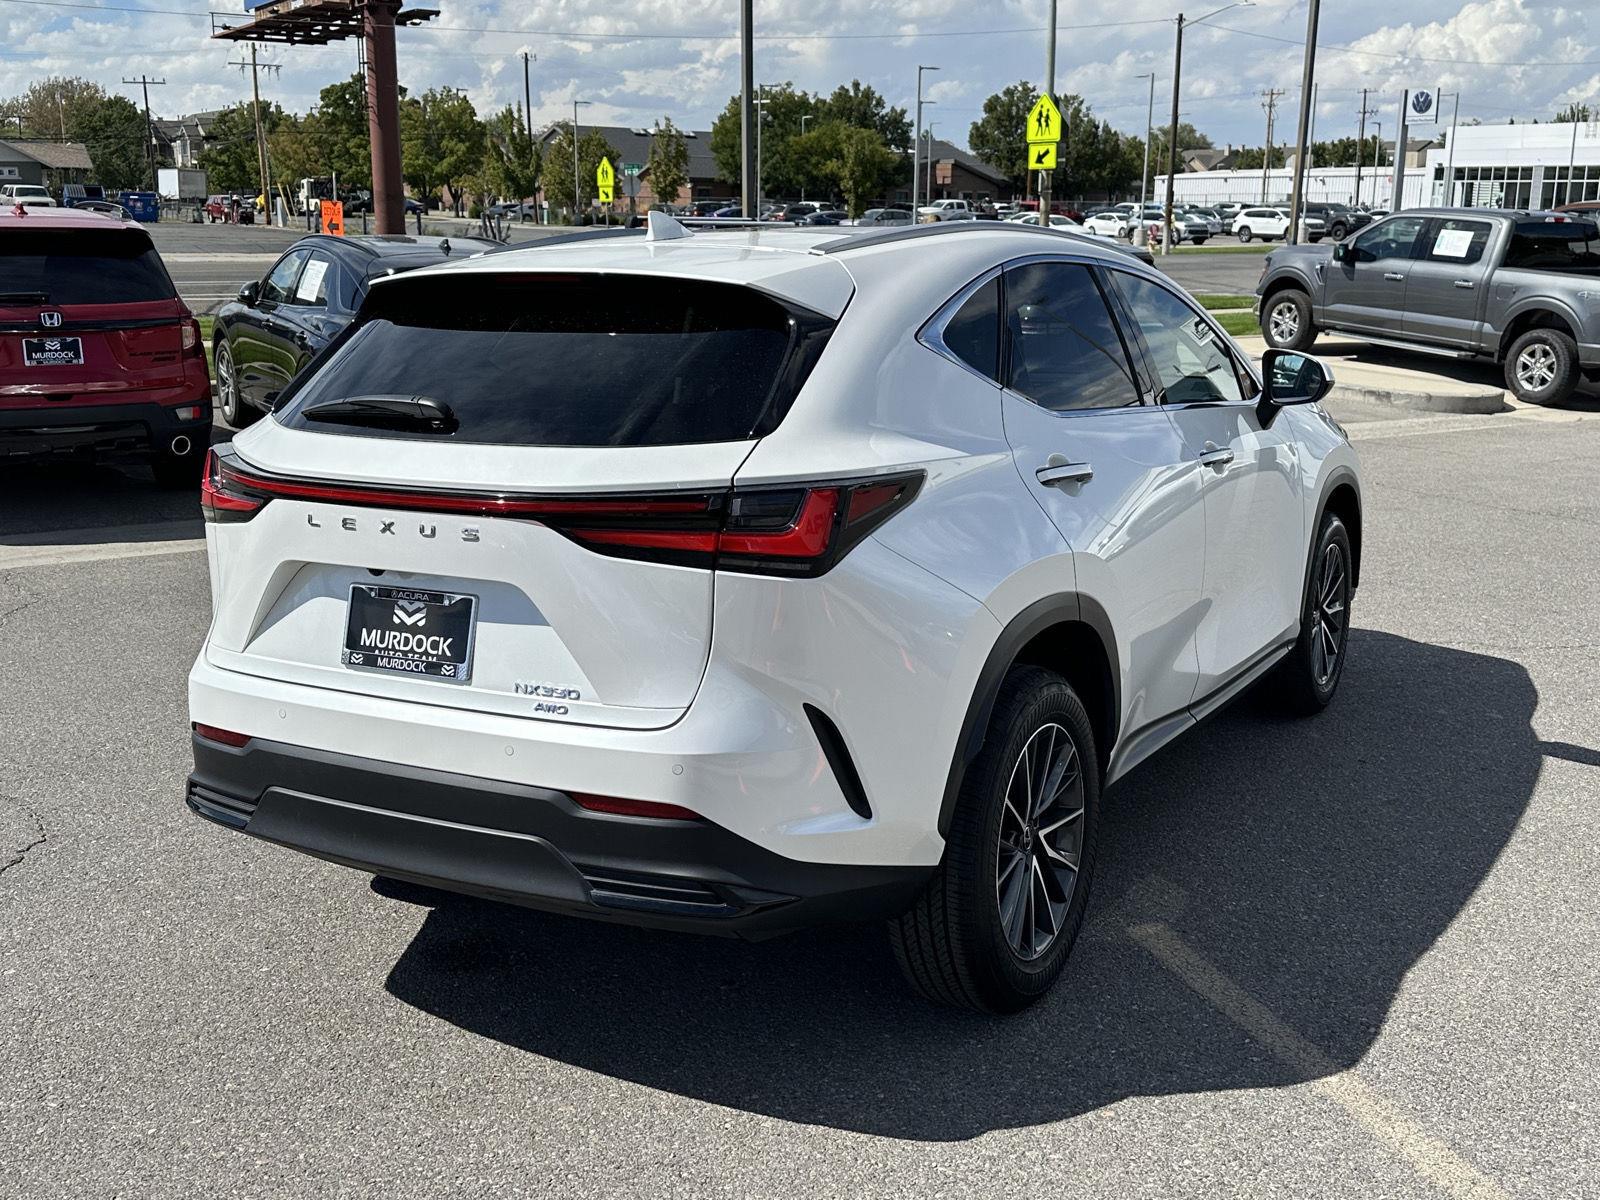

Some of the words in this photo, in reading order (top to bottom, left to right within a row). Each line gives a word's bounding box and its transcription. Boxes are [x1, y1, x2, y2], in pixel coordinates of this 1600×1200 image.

[32, 351, 75, 359] MURDOCK
[307, 514, 480, 542] LEXUS
[398, 593, 429, 601] ACURA
[360, 627, 453, 656] MURDOCK
[377, 656, 427, 673] MURDOCK
